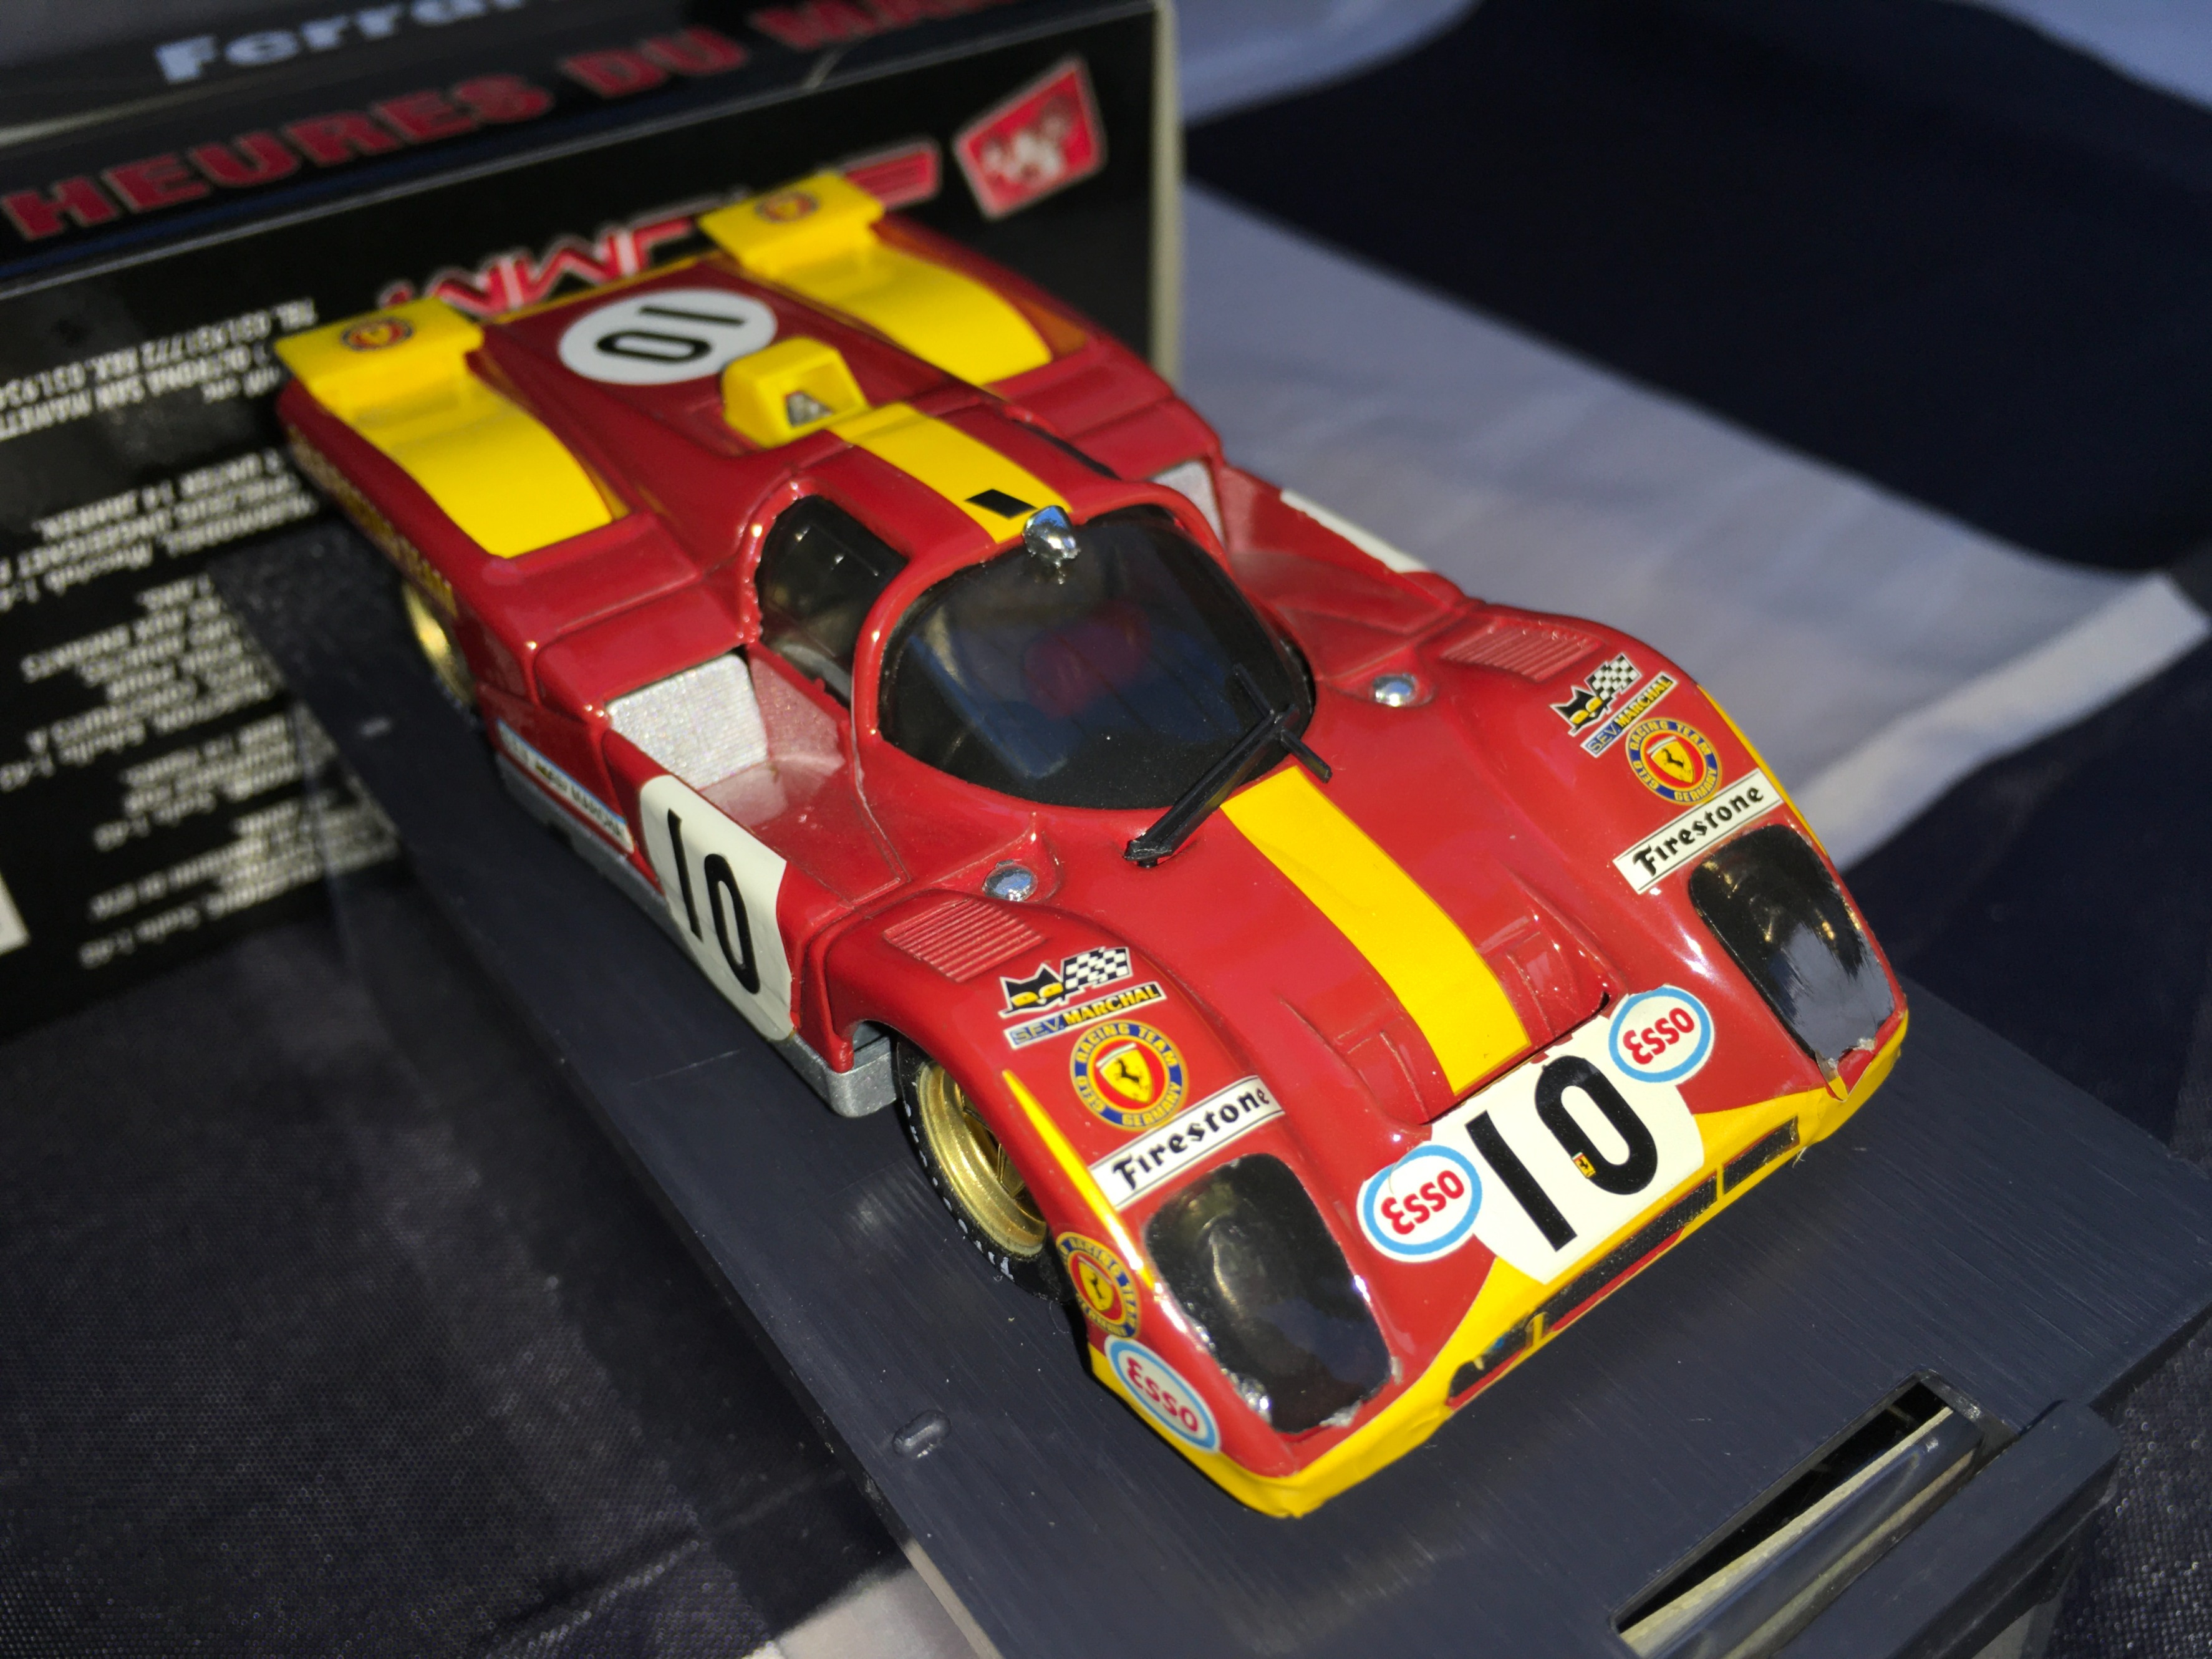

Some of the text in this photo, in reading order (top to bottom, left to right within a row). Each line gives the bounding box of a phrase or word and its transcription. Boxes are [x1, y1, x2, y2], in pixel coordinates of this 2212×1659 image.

[2, 27, 746, 241] HEURES DU
[596, 306, 750, 364] 10
[1614, 679, 1673, 728] MARCHAL
[1630, 720, 1712, 755] RACING TEAM
[1674, 767, 1717, 803] GERMANY
[1632, 785, 1764, 877] Firestone
[668, 808, 760, 995] 10
[1065, 984, 1160, 1027] MARCHAL
[1076, 1022, 1177, 1067] RACING TEAM
[1121, 1081, 1182, 1126] GERMANY
[1112, 1086, 1271, 1191] Firestone
[1465, 1055, 1658, 1252] 10
